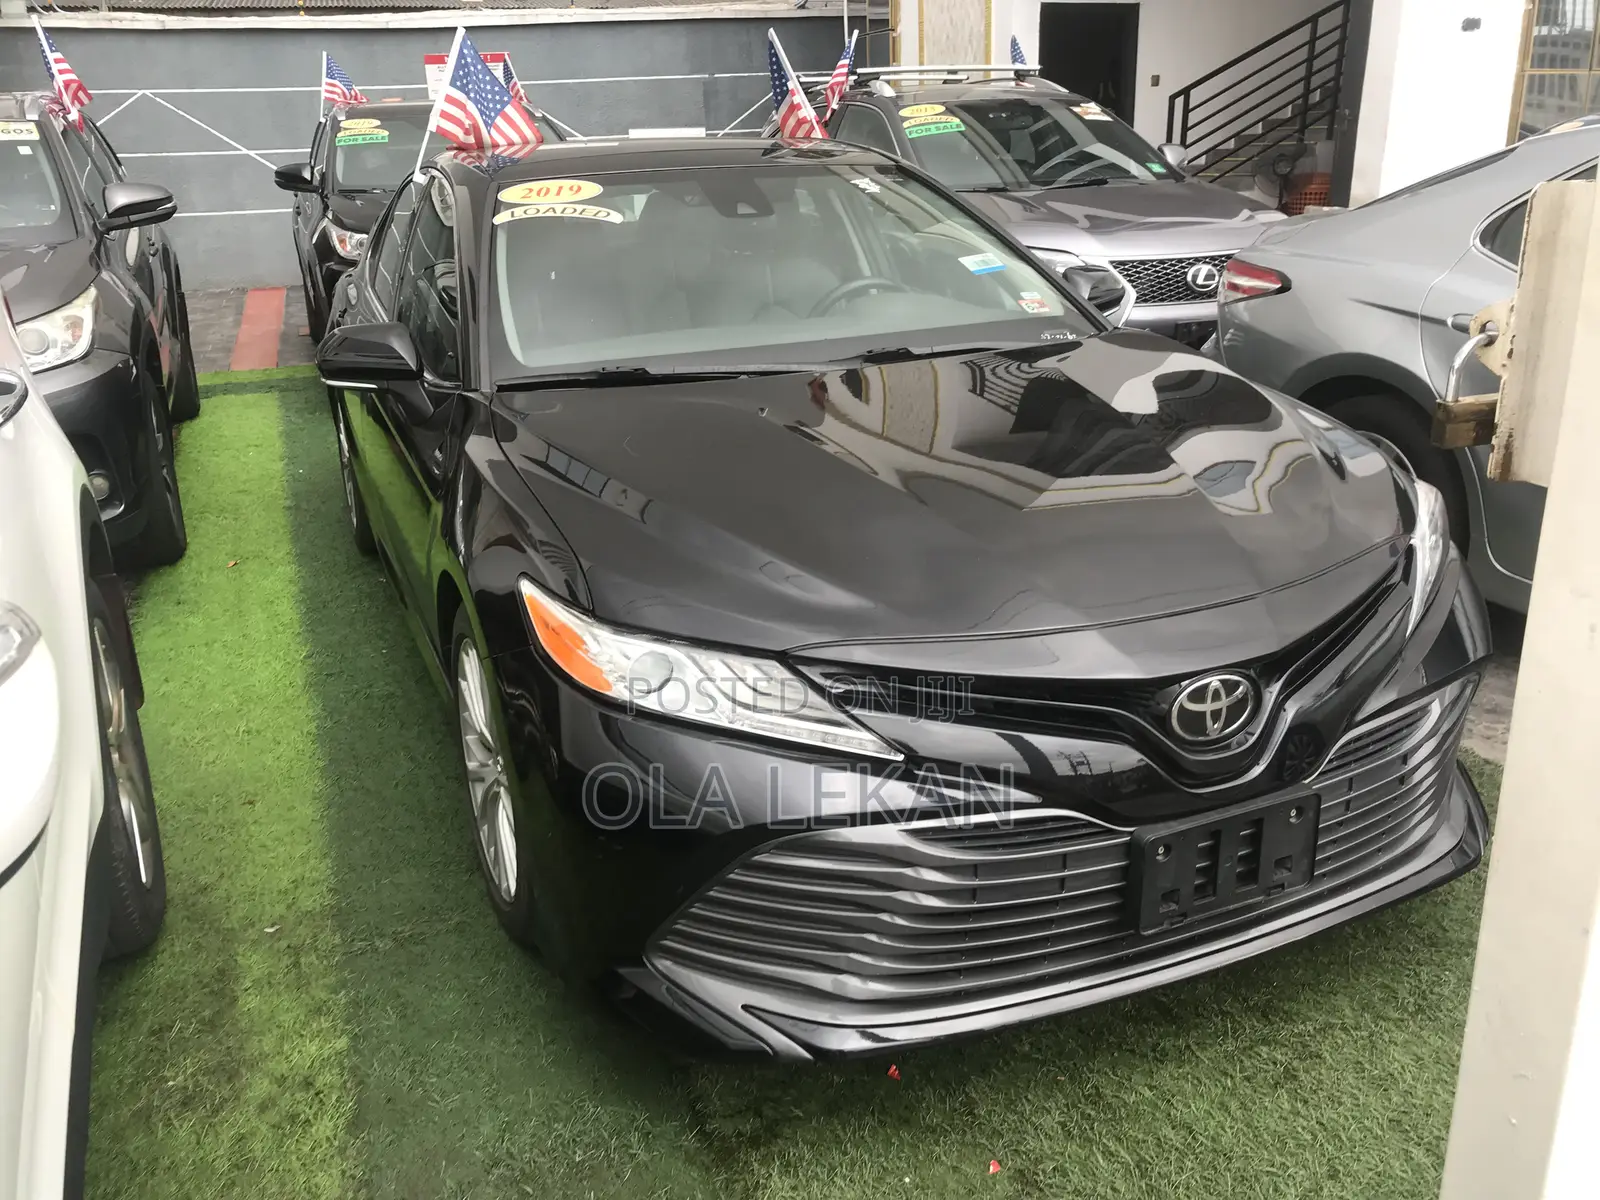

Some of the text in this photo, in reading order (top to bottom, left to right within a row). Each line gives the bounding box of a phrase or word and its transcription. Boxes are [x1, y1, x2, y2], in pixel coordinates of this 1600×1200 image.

[908, 123, 963, 136] FOR SALE
[520, 184, 583, 199] 2019
[509, 206, 611, 219] LOADED
